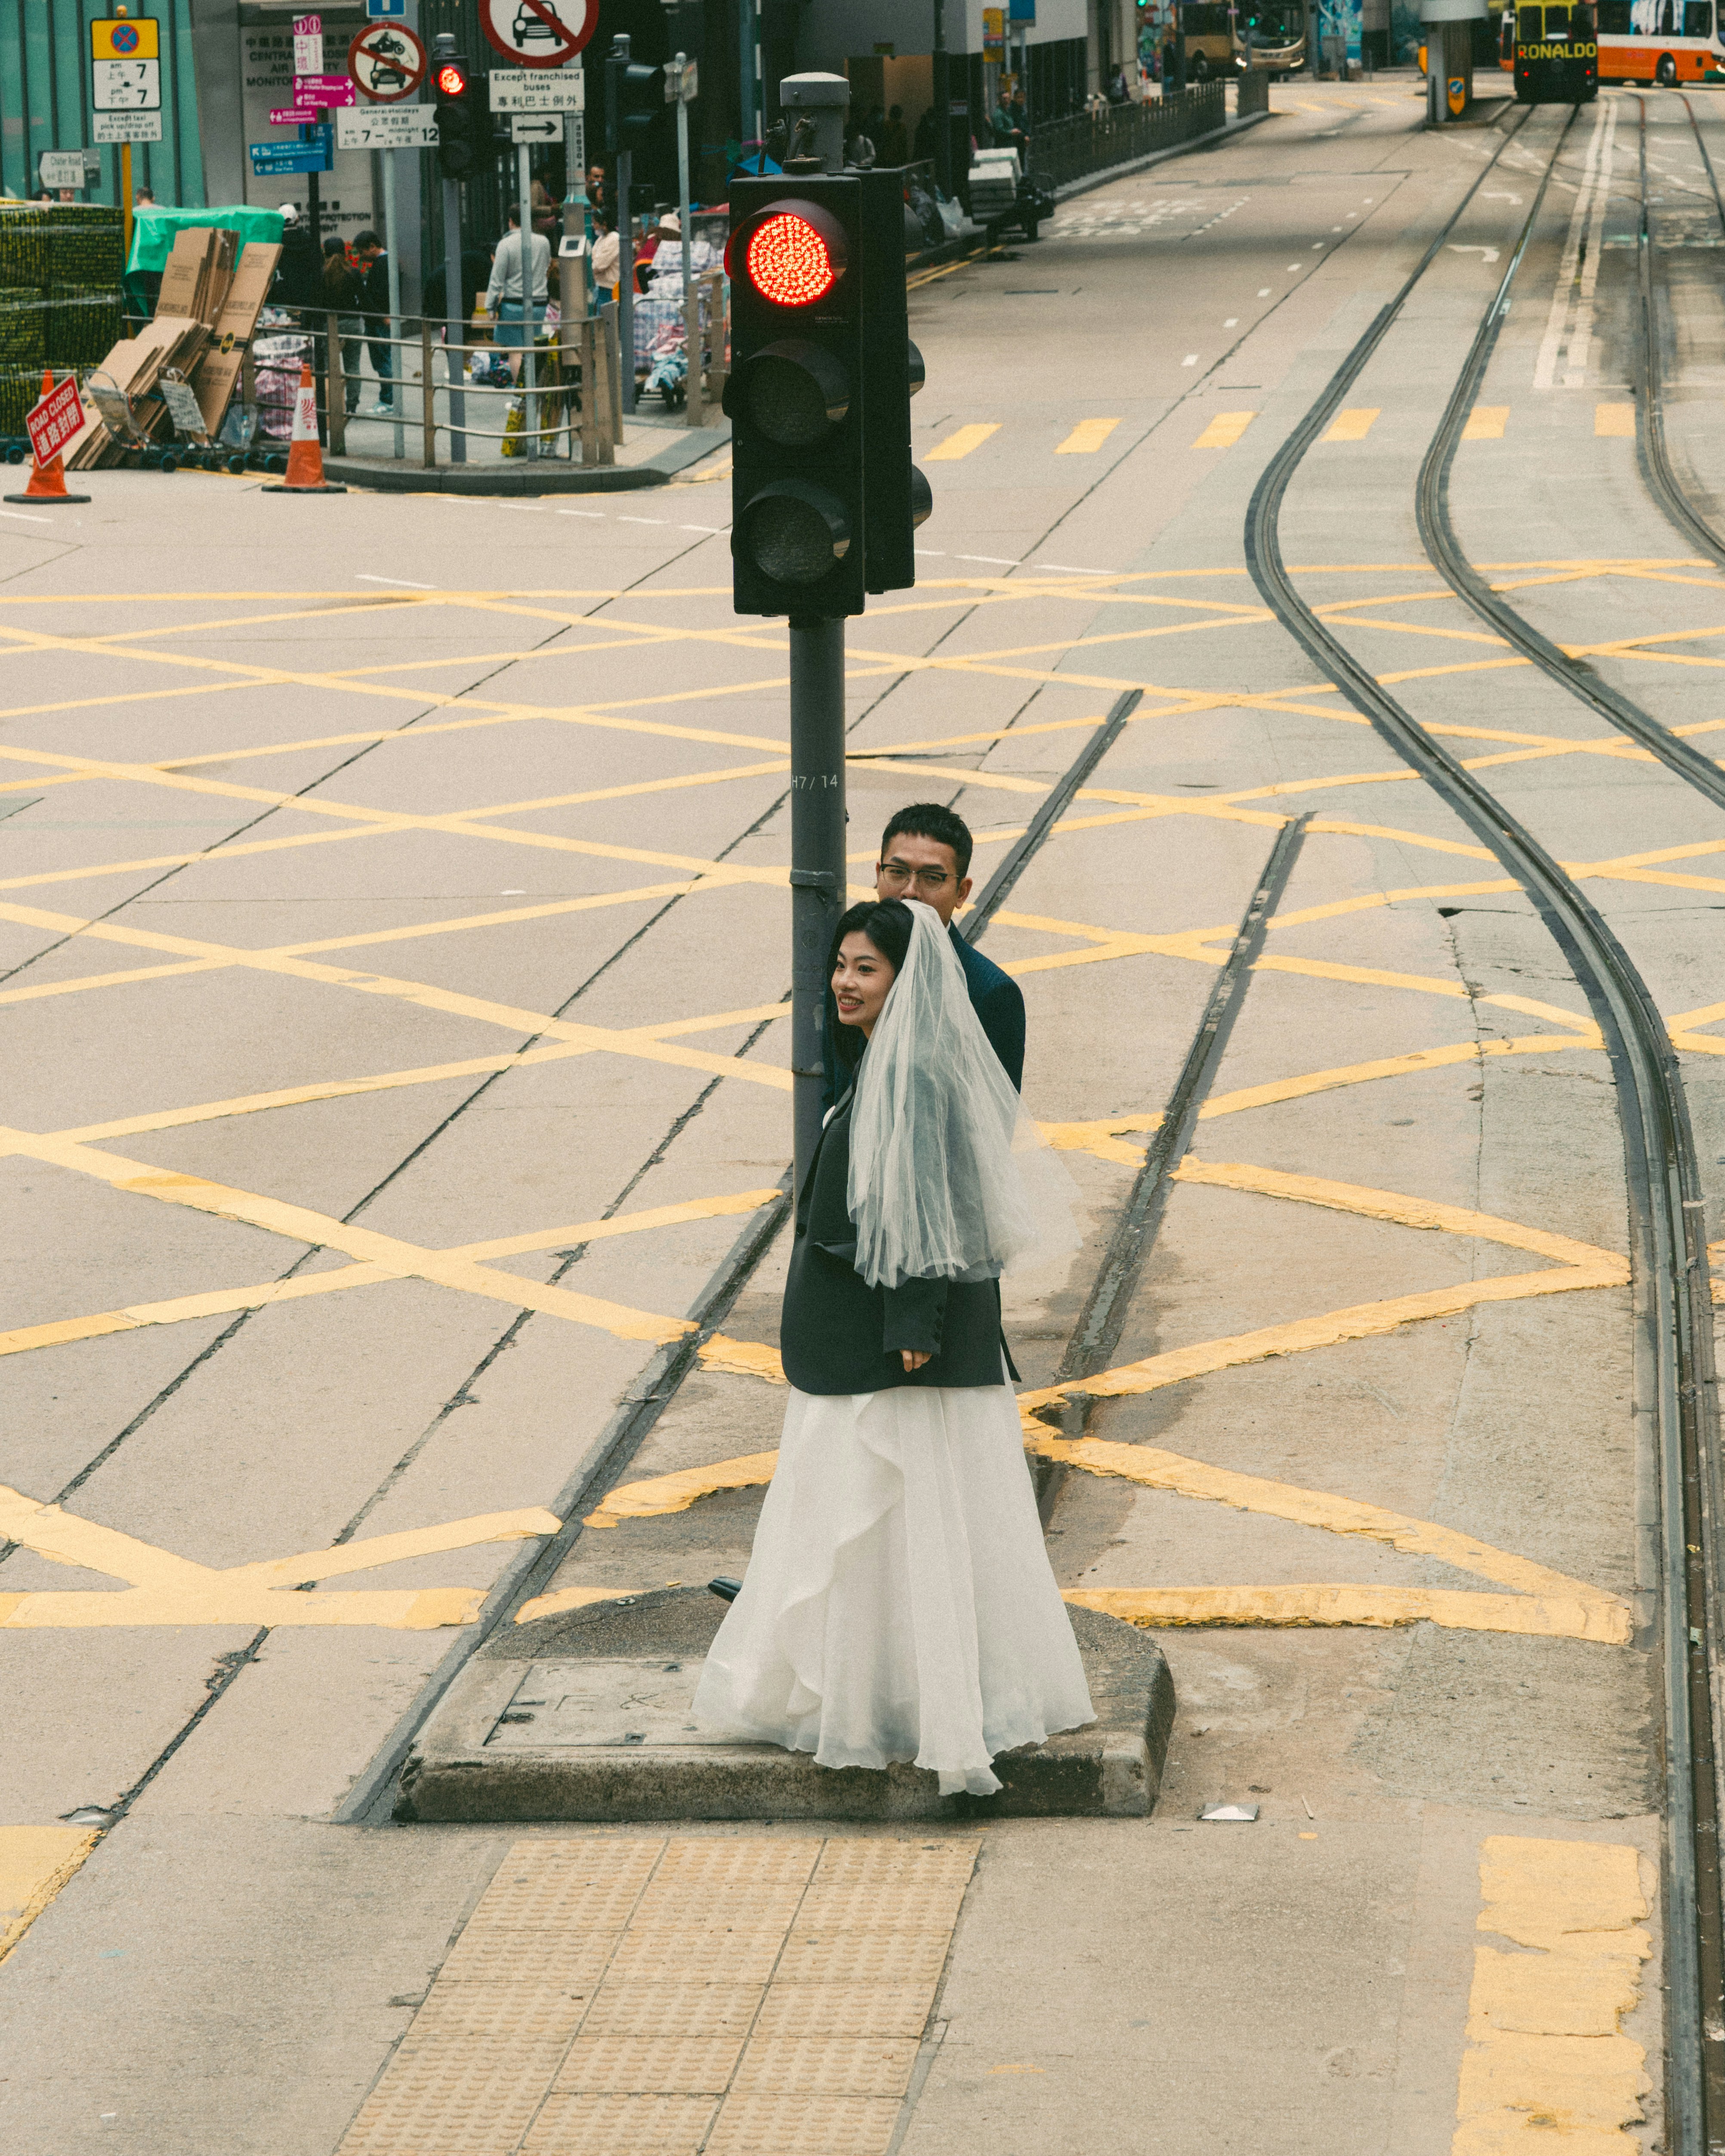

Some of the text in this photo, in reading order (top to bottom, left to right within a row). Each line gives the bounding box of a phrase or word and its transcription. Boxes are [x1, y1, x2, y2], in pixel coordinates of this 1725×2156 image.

[296, 40, 308, 71] 中環
[1518, 43, 1597, 59] RONALDO
[108, 71, 125, 80] 上午
[136, 64, 146, 79] 7
[494, 72, 580, 81] Except franchised
[137, 89, 147, 104] 7
[498, 95, 577, 107] 專利巴士例外
[361, 130, 371, 142] 7
[422, 128, 438, 141] 12
[30, 385, 74, 435] ROAD CLOSED
[36, 401, 80, 457] 道路封閉
